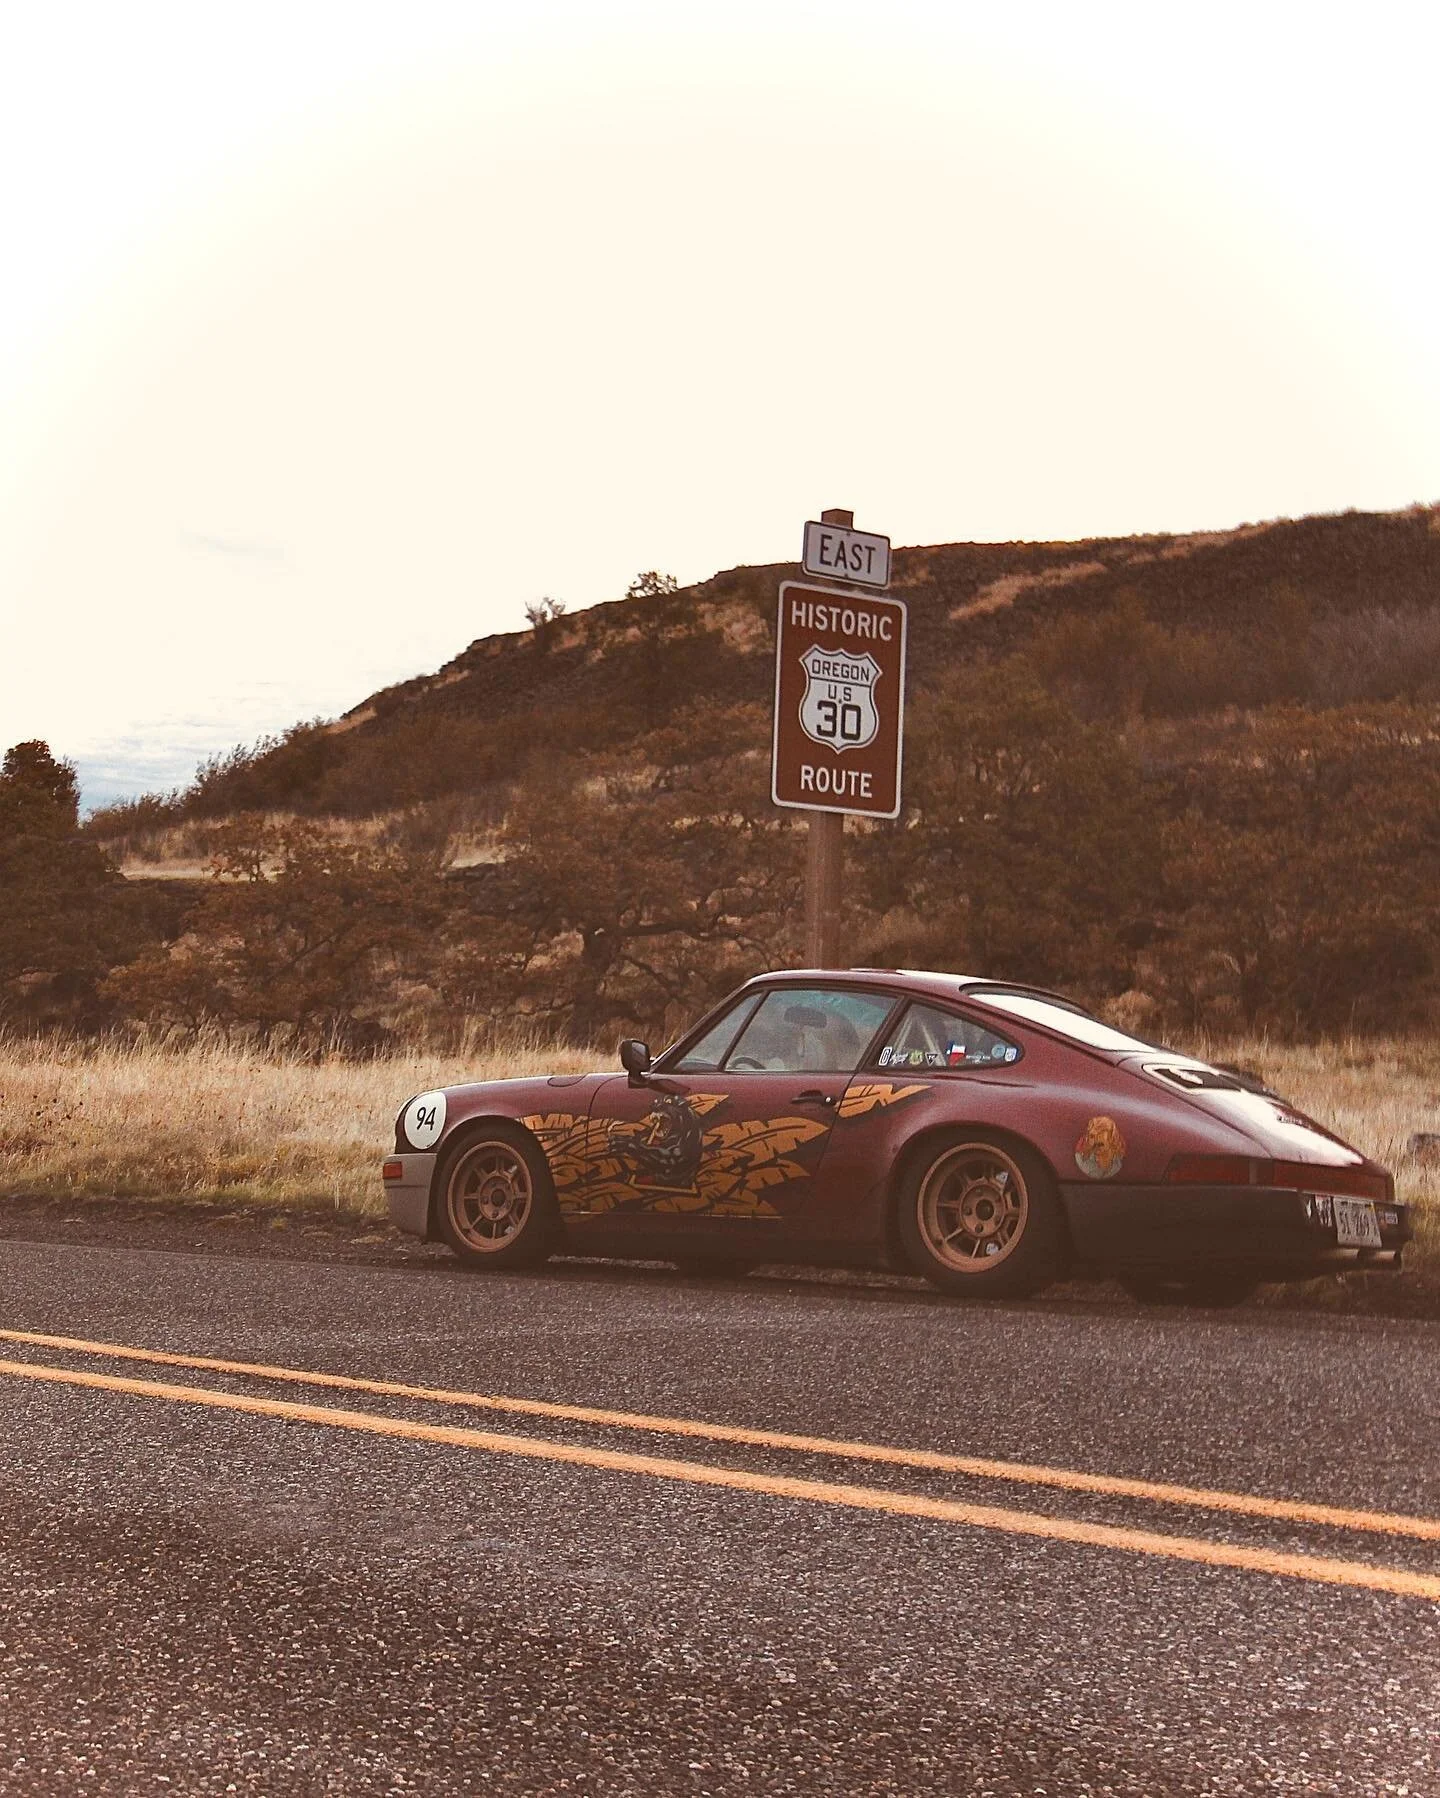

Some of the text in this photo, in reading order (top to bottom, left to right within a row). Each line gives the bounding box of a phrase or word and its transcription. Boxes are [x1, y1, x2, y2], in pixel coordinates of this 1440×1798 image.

[819, 534, 876, 574] EAST
[791, 600, 893, 641] HISTORIC
[812, 659, 870, 682] OREGON
[816, 700, 862, 741] 30
[800, 765, 873, 798] ROUTE
[416, 1106, 437, 1131] 94
